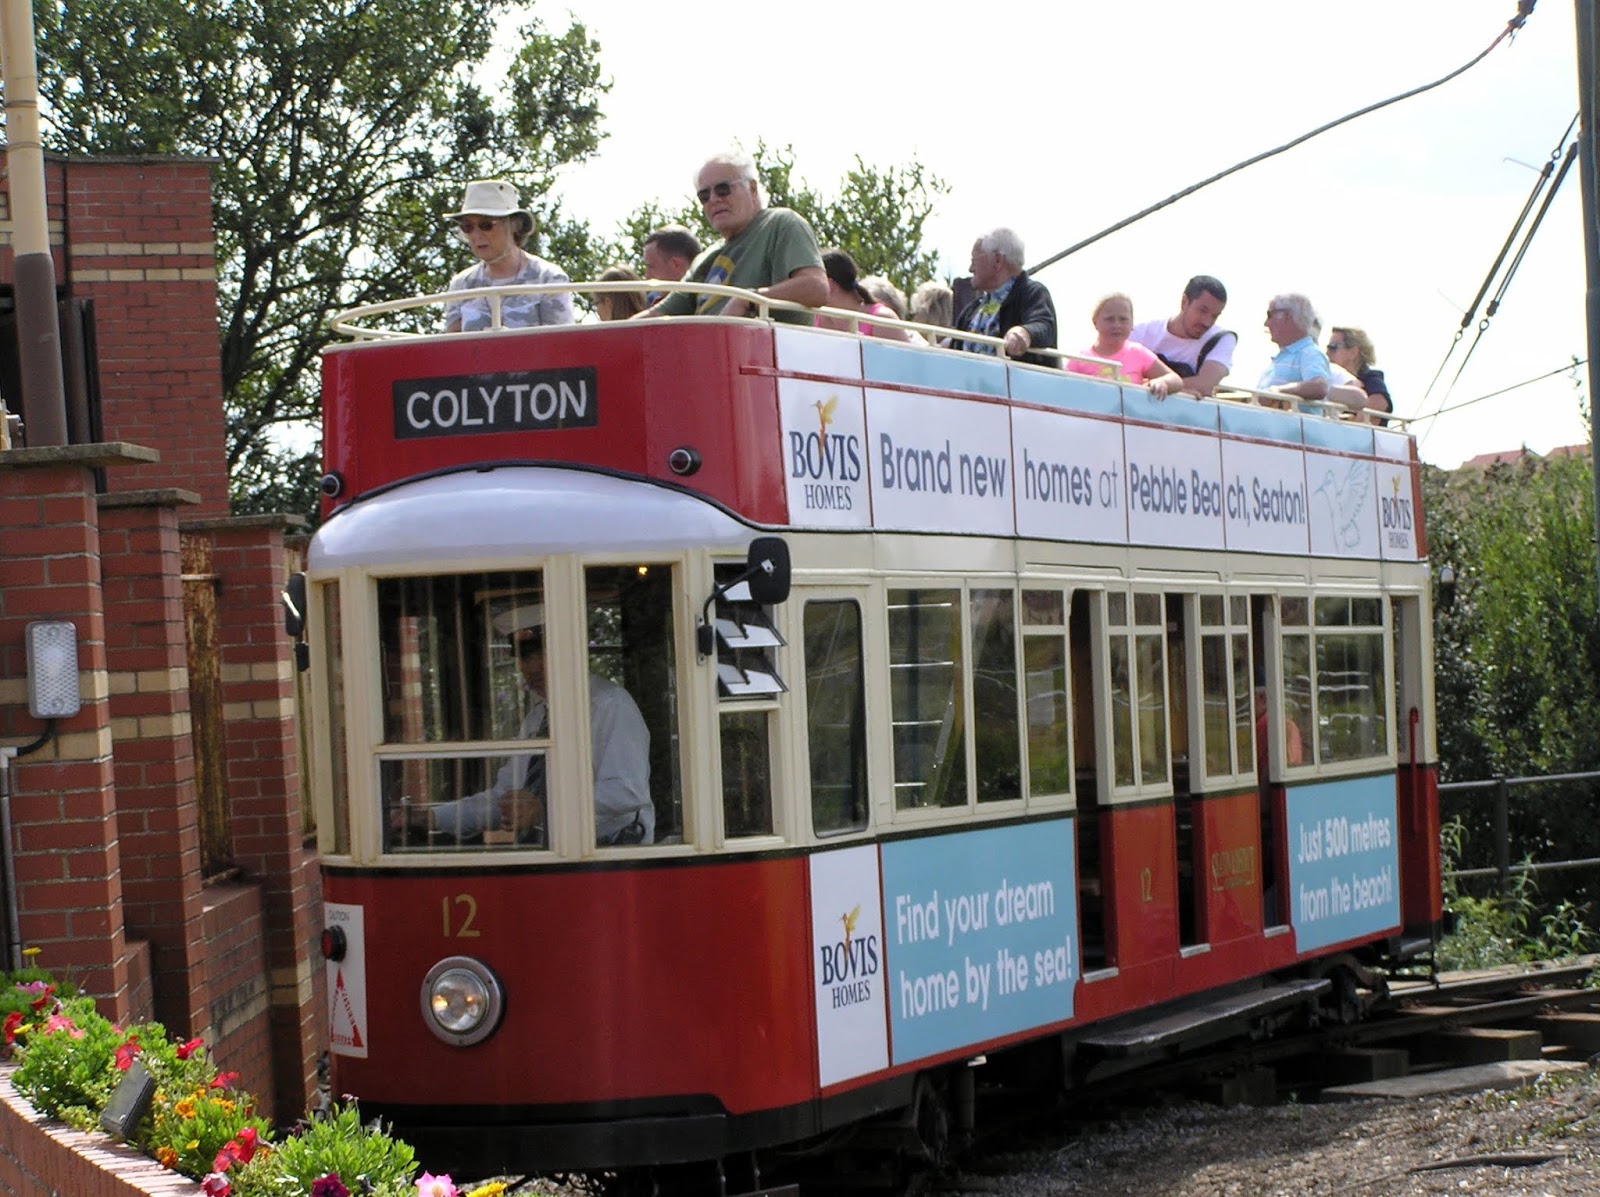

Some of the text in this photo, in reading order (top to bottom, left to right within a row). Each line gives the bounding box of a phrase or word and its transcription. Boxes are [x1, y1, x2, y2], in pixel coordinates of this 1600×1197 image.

[406, 380, 587, 429] COLYTON
[789, 431, 861, 482] BOVIS
[880, 433, 952, 494] Brand
[960, 452, 1006, 497] new
[1024, 448, 1092, 506] homes
[1099, 461, 1118, 509] at
[1130, 463, 1187, 514] Pebble
[1253, 476, 1306, 525] Seaton!
[804, 484, 852, 511] HOMES
[1298, 812, 1390, 864] Just 500 metres
[442, 894, 481, 938] 12
[896, 878, 1054, 946] Find your dream
[1300, 865, 1392, 922] from the beach!
[820, 935, 878, 986] BOVIS
[900, 935, 1072, 1019] home by the sea!
[831, 980, 871, 1009] HOMES
